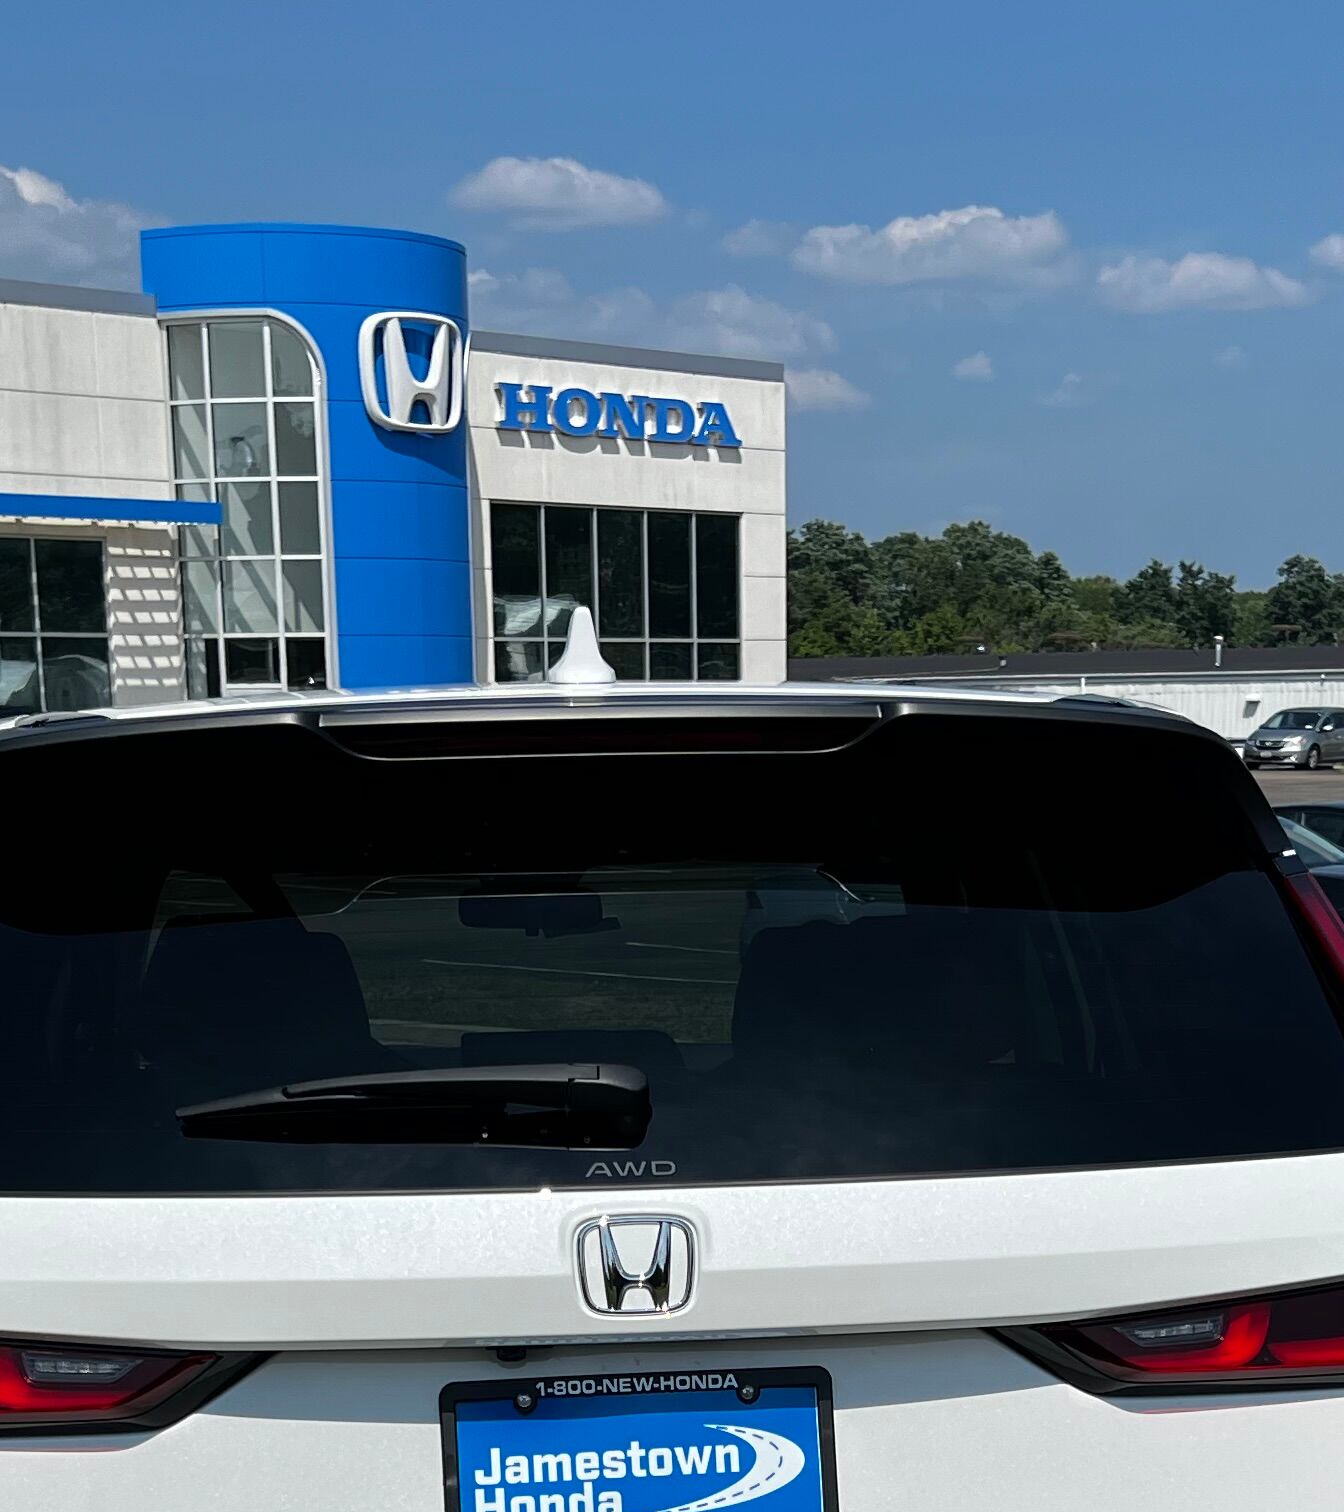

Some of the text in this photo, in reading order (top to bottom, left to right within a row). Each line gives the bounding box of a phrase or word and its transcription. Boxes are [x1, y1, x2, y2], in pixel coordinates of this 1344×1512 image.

[496, 382, 742, 448] HONDA
[585, 1160, 677, 1178] AWD
[535, 1373, 739, 1397] 1-800-NEW-HONDA
[474, 1439, 740, 1486] Jamestown
